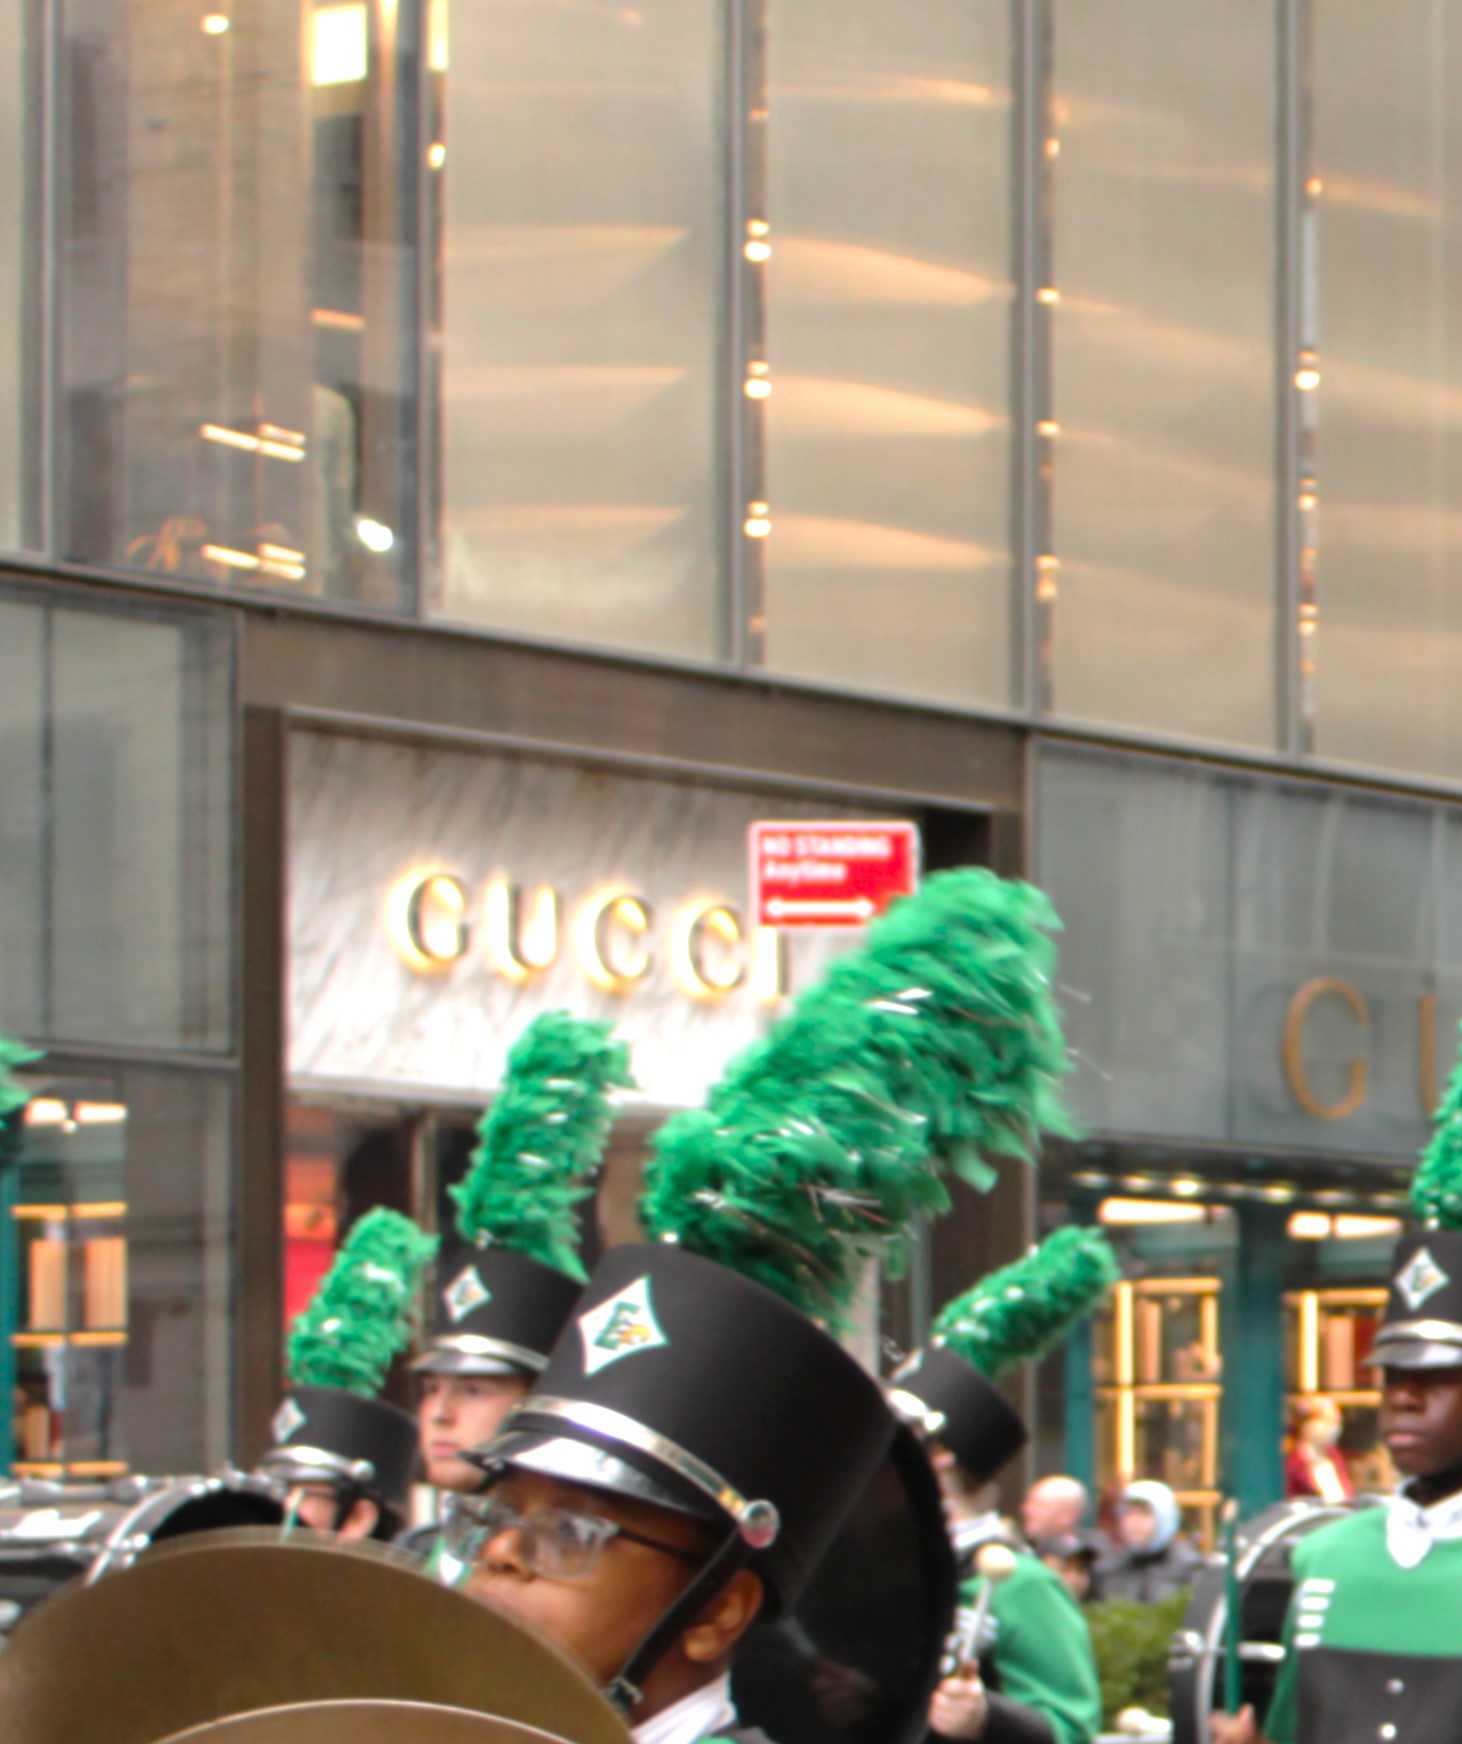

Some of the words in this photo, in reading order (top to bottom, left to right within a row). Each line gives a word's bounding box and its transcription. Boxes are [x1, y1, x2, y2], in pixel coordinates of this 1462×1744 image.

[763, 836, 791, 857] NO
[796, 836, 891, 859] STANDING
[764, 861, 847, 886] Anytime
[390, 865, 790, 1006] GUCCI
